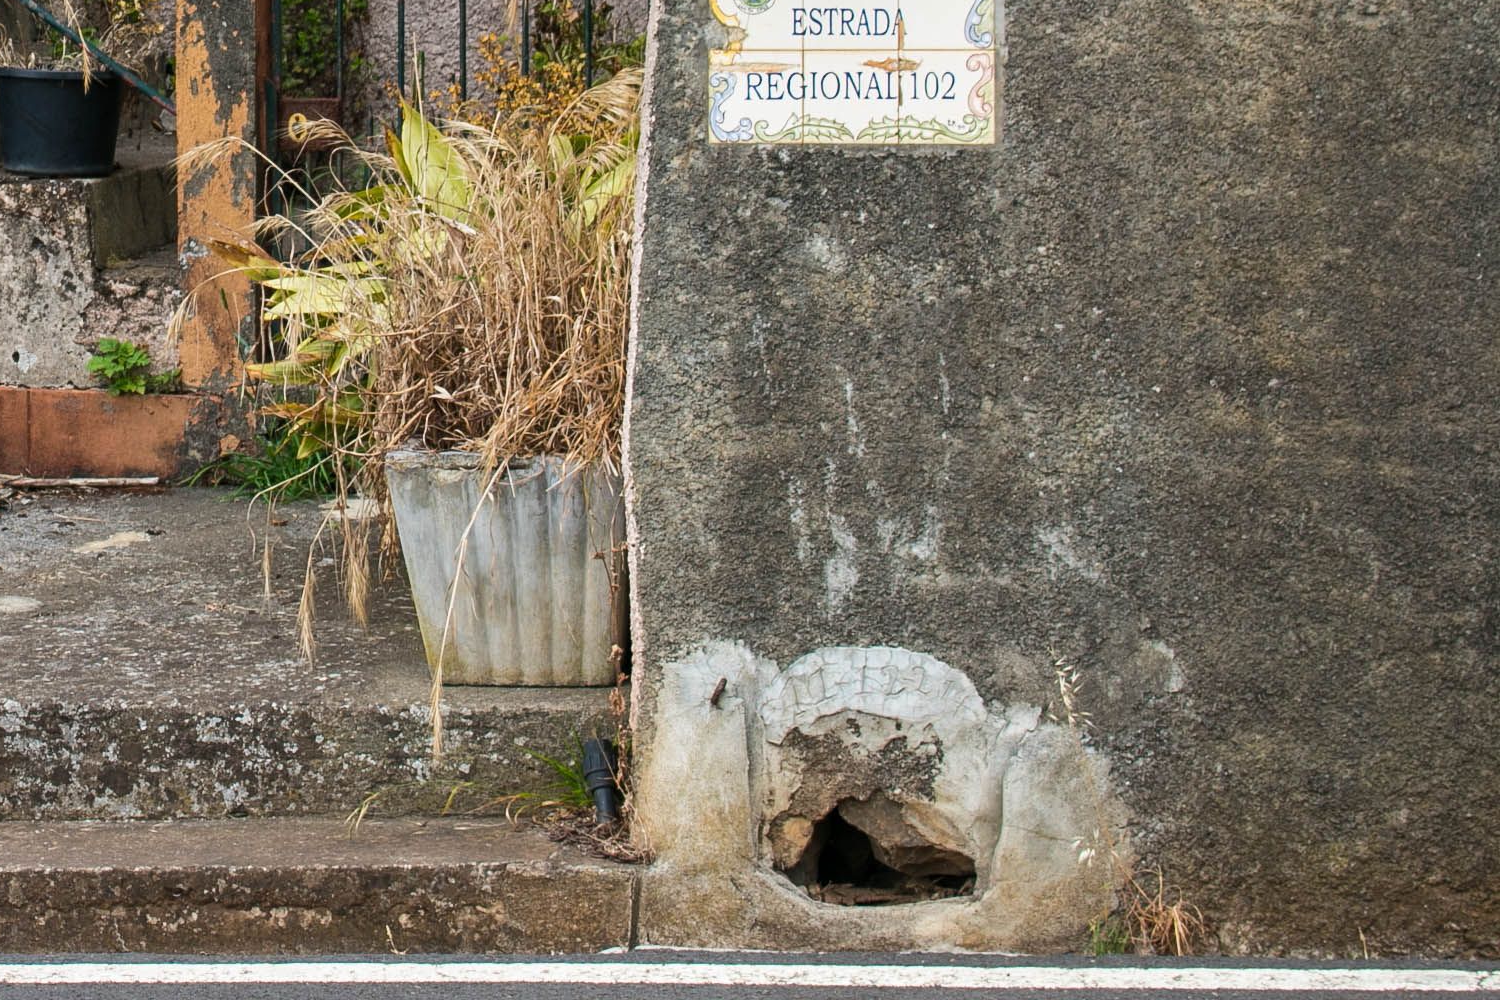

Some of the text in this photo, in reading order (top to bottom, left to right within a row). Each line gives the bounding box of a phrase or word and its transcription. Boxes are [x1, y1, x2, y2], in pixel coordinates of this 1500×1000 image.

[792, 7, 907, 36] ESTRADA
[745, 71, 956, 101] REGIONAL 102
